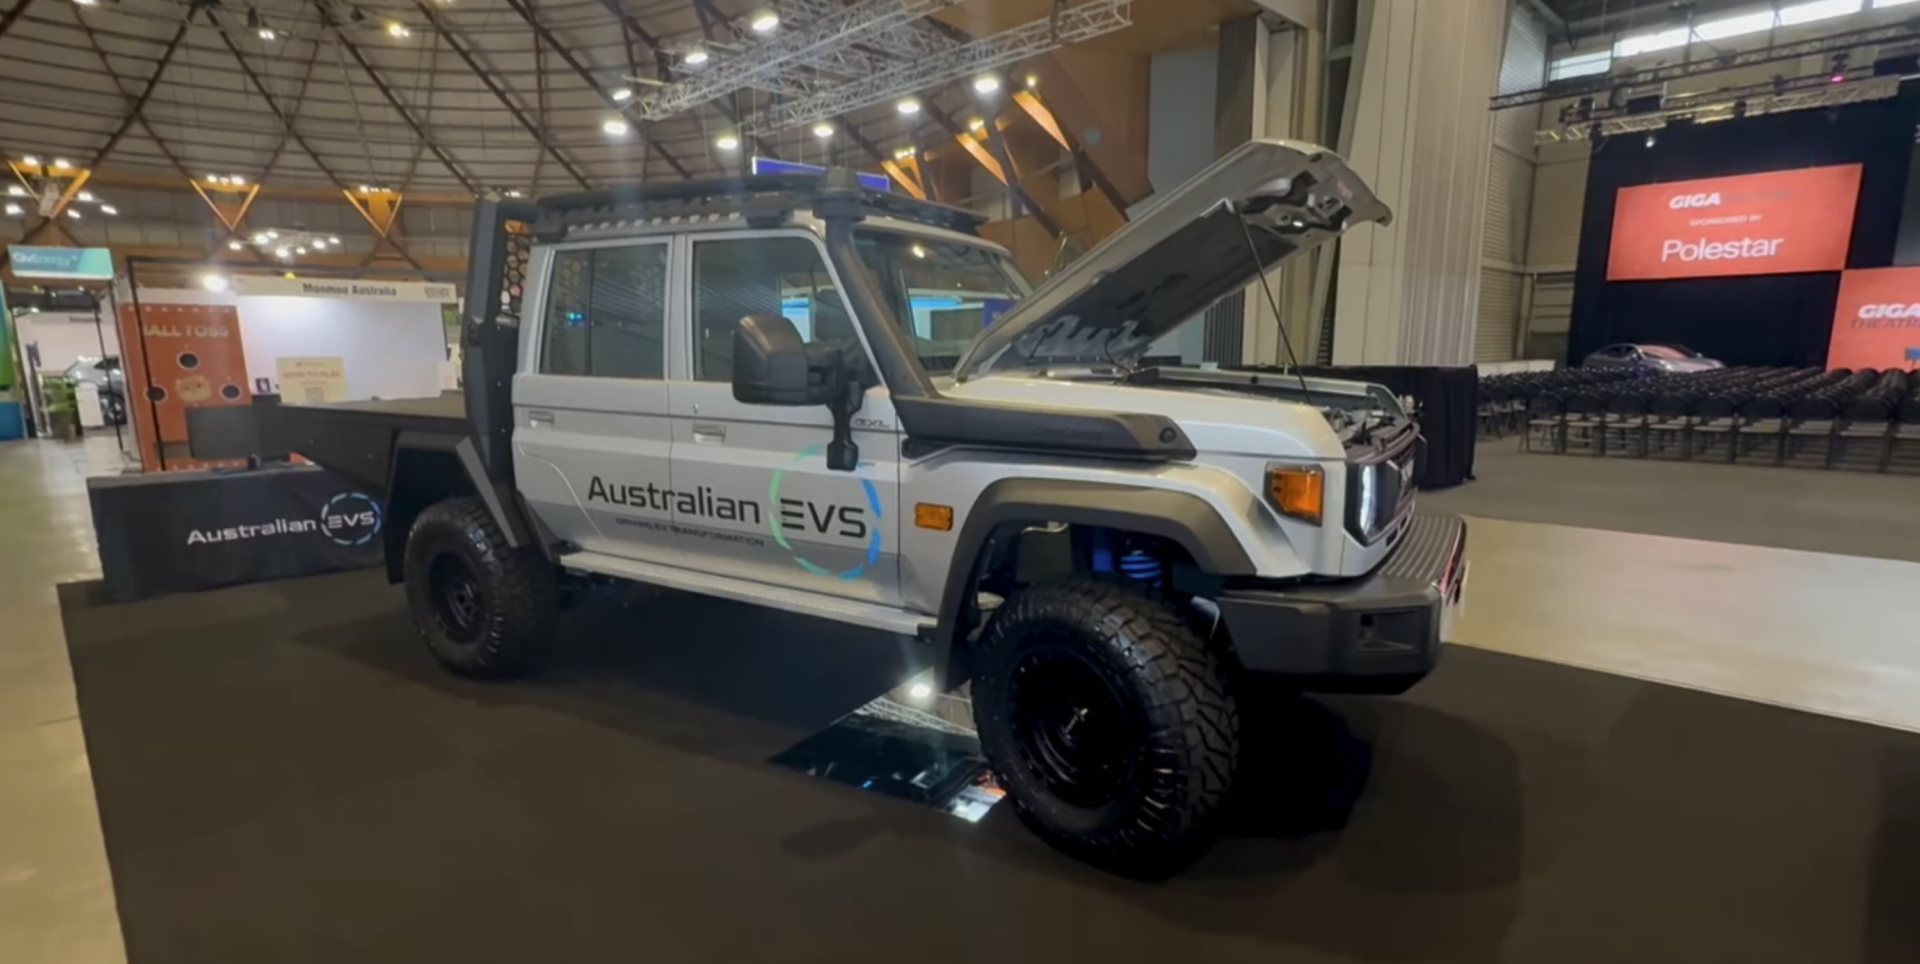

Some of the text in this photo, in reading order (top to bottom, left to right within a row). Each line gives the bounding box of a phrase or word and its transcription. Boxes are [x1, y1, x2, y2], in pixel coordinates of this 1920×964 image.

[1669, 192, 1721, 210] GIGA
[1689, 213, 1763, 227] SPONSORED BY
[1661, 237, 1785, 263] Polestar
[302, 282, 397, 297] Moomoo Australia
[1858, 303, 1920, 319] GIGA
[1850, 319, 1920, 330] THEATR
[588, 476, 867, 539] Australian EVS
[187, 511, 376, 545] Australian EVS
[615, 517, 653, 530] DRIVING
[669, 524, 765, 547] TRANSFORMATION
